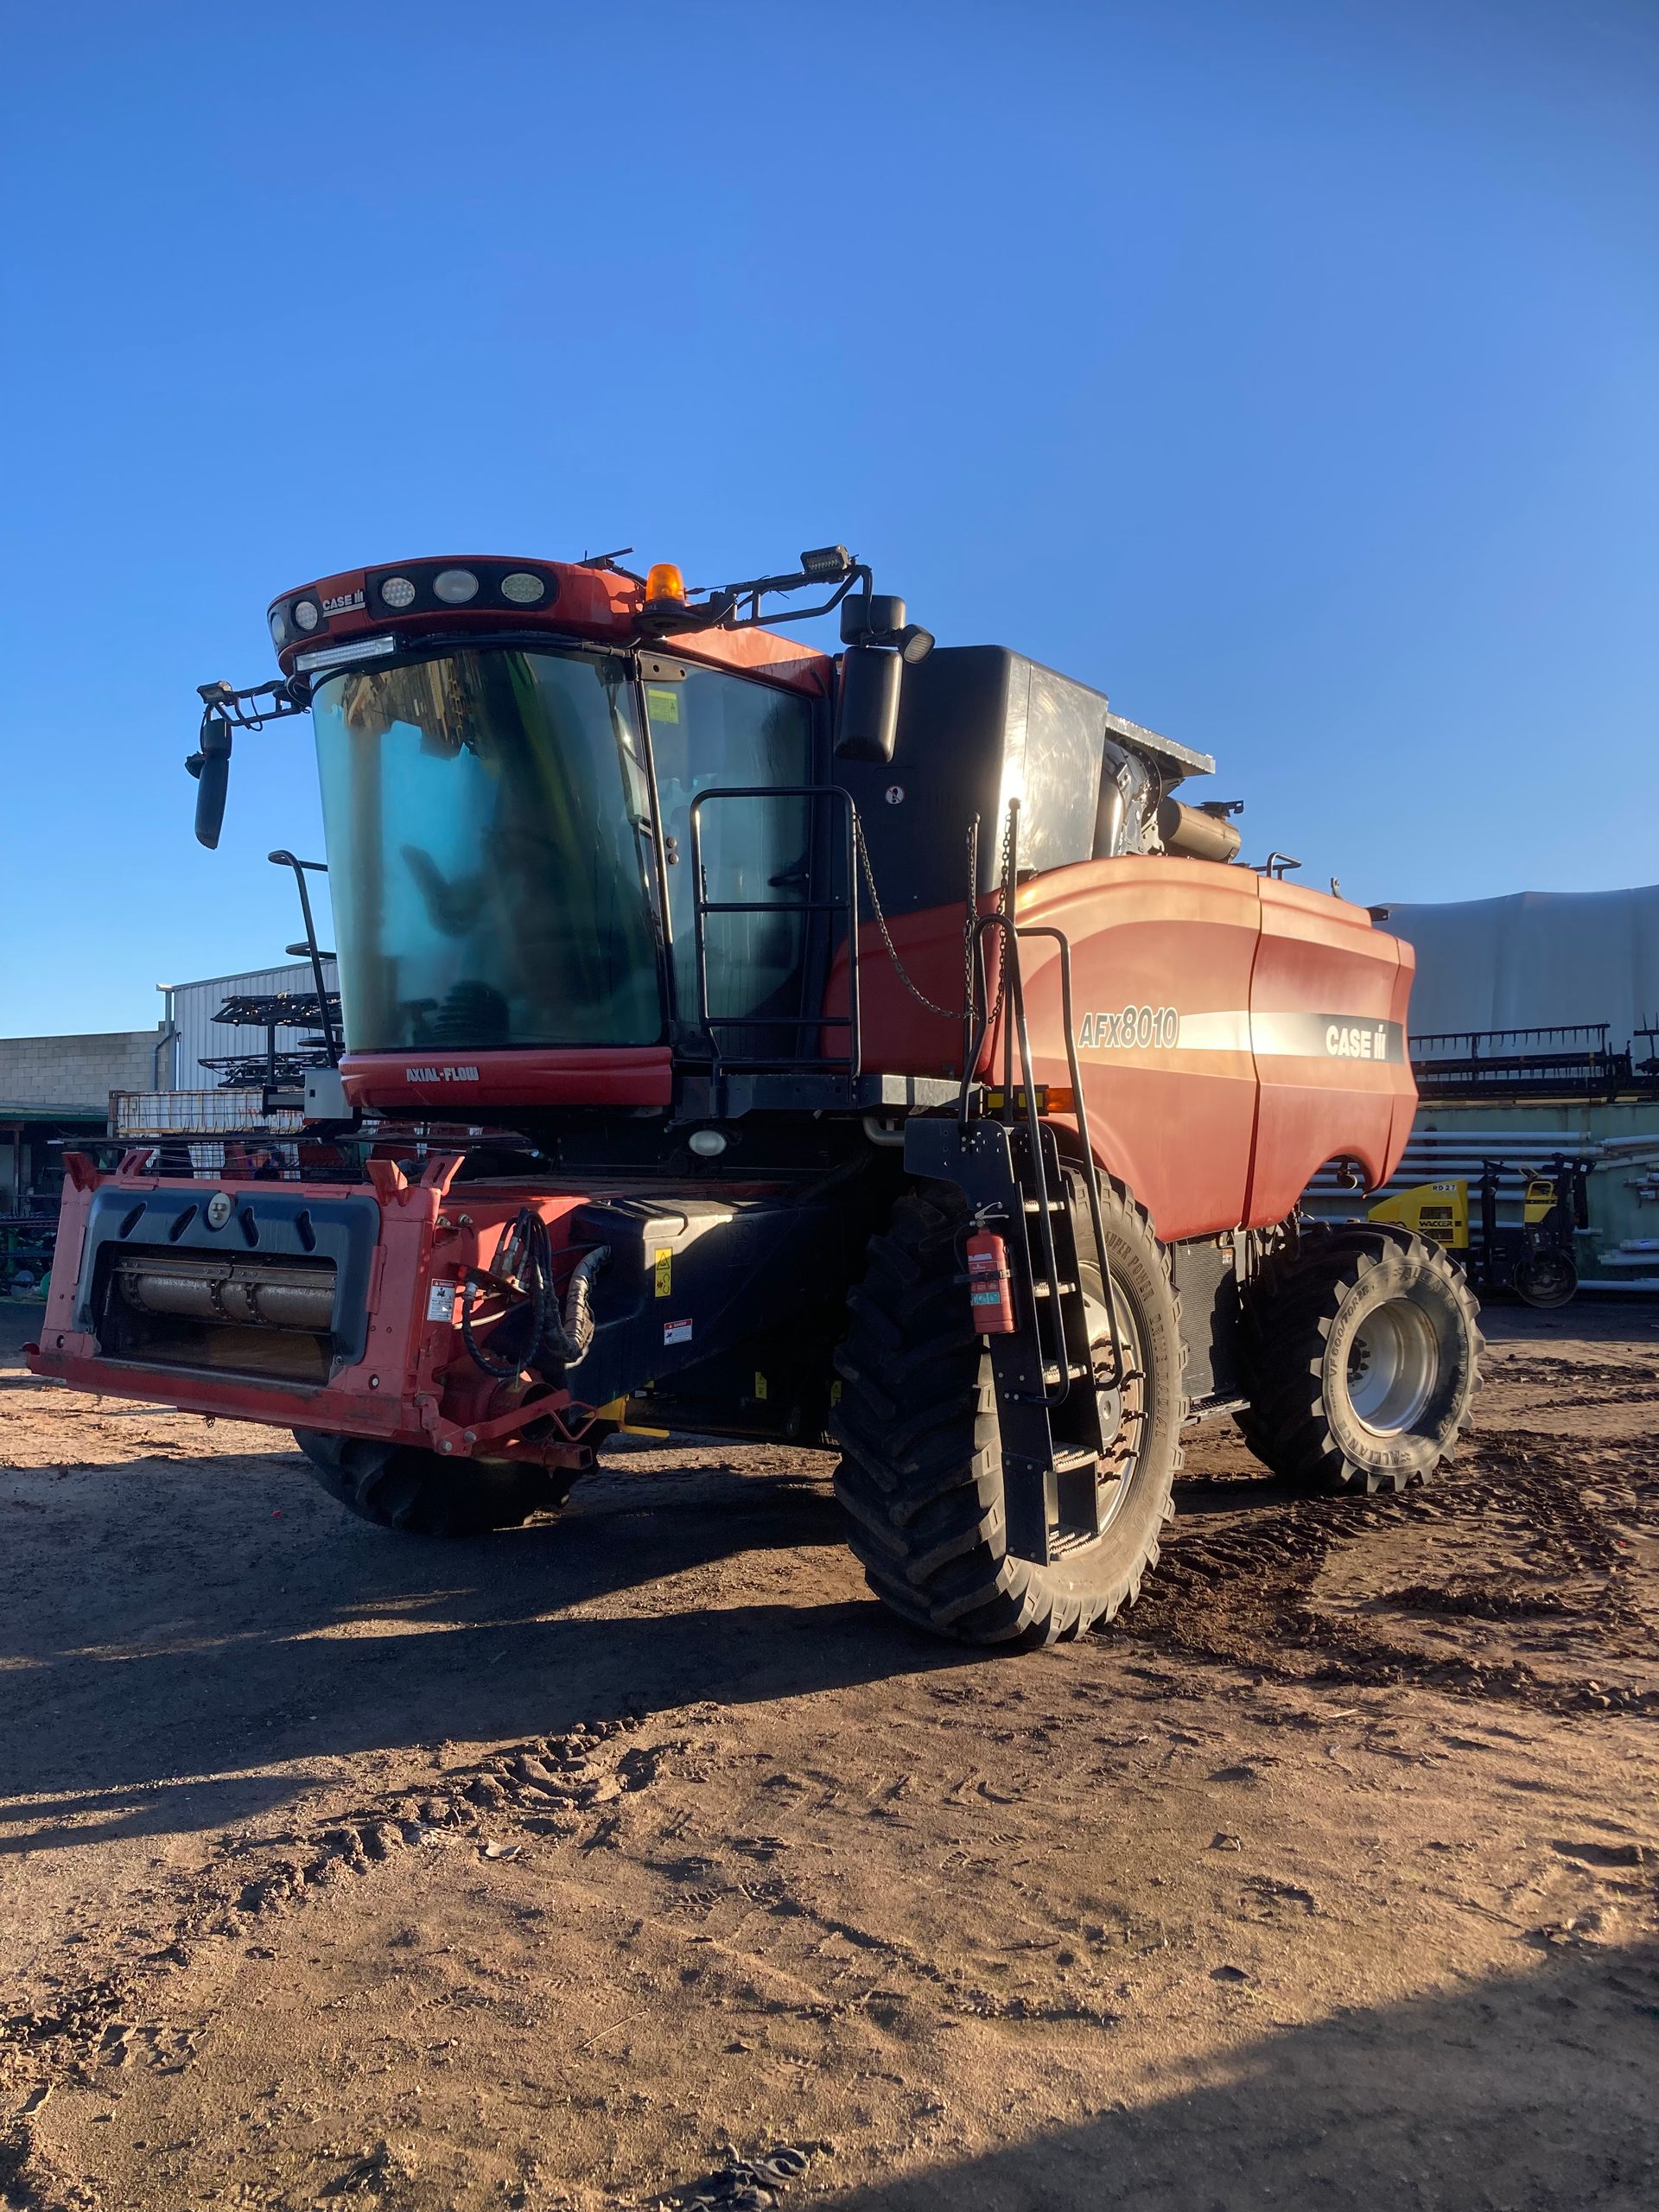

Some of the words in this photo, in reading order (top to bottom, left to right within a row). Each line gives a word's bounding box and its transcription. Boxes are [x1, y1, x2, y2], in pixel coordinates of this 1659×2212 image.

[322, 594, 353, 611] CASE
[1077, 1005, 1179, 1049] AFX8010
[1325, 1025, 1371, 1058] CASE
[406, 1066, 480, 1082] AXIAL-FLOW
[1105, 1231, 1132, 1259] SUPER
[1128, 1255, 1155, 1302] POWER
[1336, 1421, 1401, 1465] ALLIANCE
